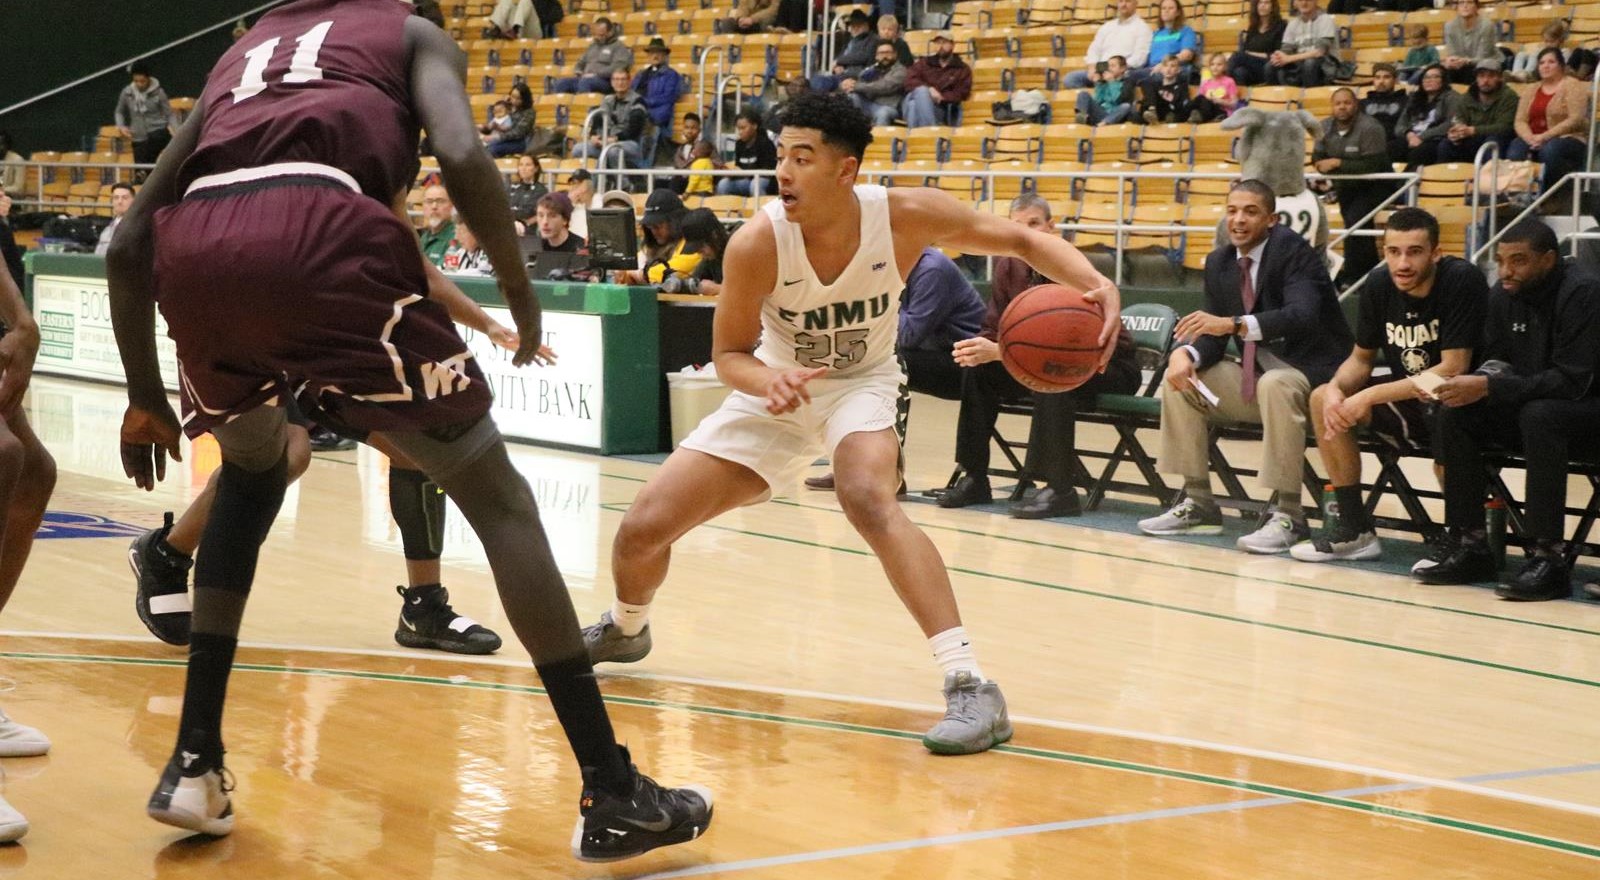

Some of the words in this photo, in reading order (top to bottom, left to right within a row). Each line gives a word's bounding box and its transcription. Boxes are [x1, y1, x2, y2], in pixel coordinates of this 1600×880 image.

[231, 20, 335, 104] 11
[778, 292, 889, 330] ENMU
[794, 328, 870, 370] 25
[539, 379, 592, 420] BANK
